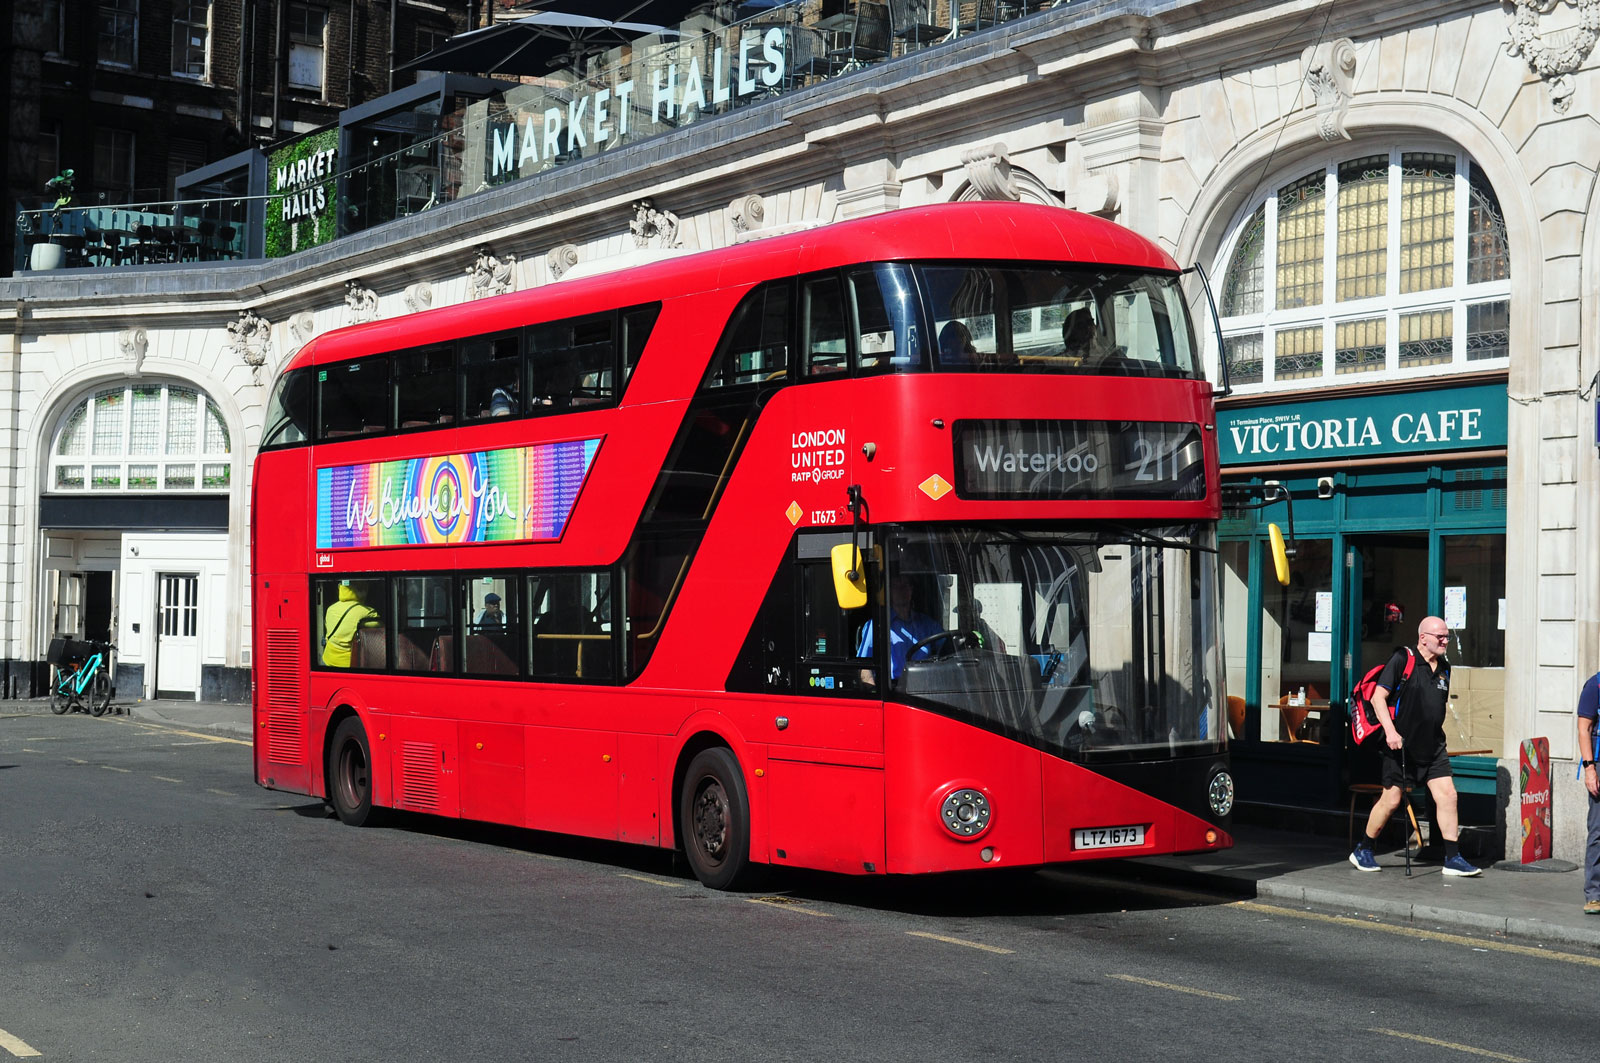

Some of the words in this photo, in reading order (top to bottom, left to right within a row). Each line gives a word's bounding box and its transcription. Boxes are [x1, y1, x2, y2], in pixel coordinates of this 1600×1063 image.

[493, 79, 633, 176] MARKET
[652, 27, 785, 124] HALLS
[277, 148, 335, 191] MARKET
[282, 185, 325, 221] HALLS
[792, 429, 845, 448] LONDON
[1230, 417, 1381, 455] VICTORIA
[1392, 409, 1482, 444] CAFE
[792, 449, 845, 468] UNITED
[973, 444, 1098, 473] Waterloo
[792, 471, 811, 482] RATP
[821, 469, 845, 480] GROUP
[346, 478, 378, 531] We
[811, 510, 836, 524] LT673
[1521, 789, 1549, 805] Thirsty?
[1082, 830, 1106, 846] LTZ
[1109, 828, 1137, 844] 1673
